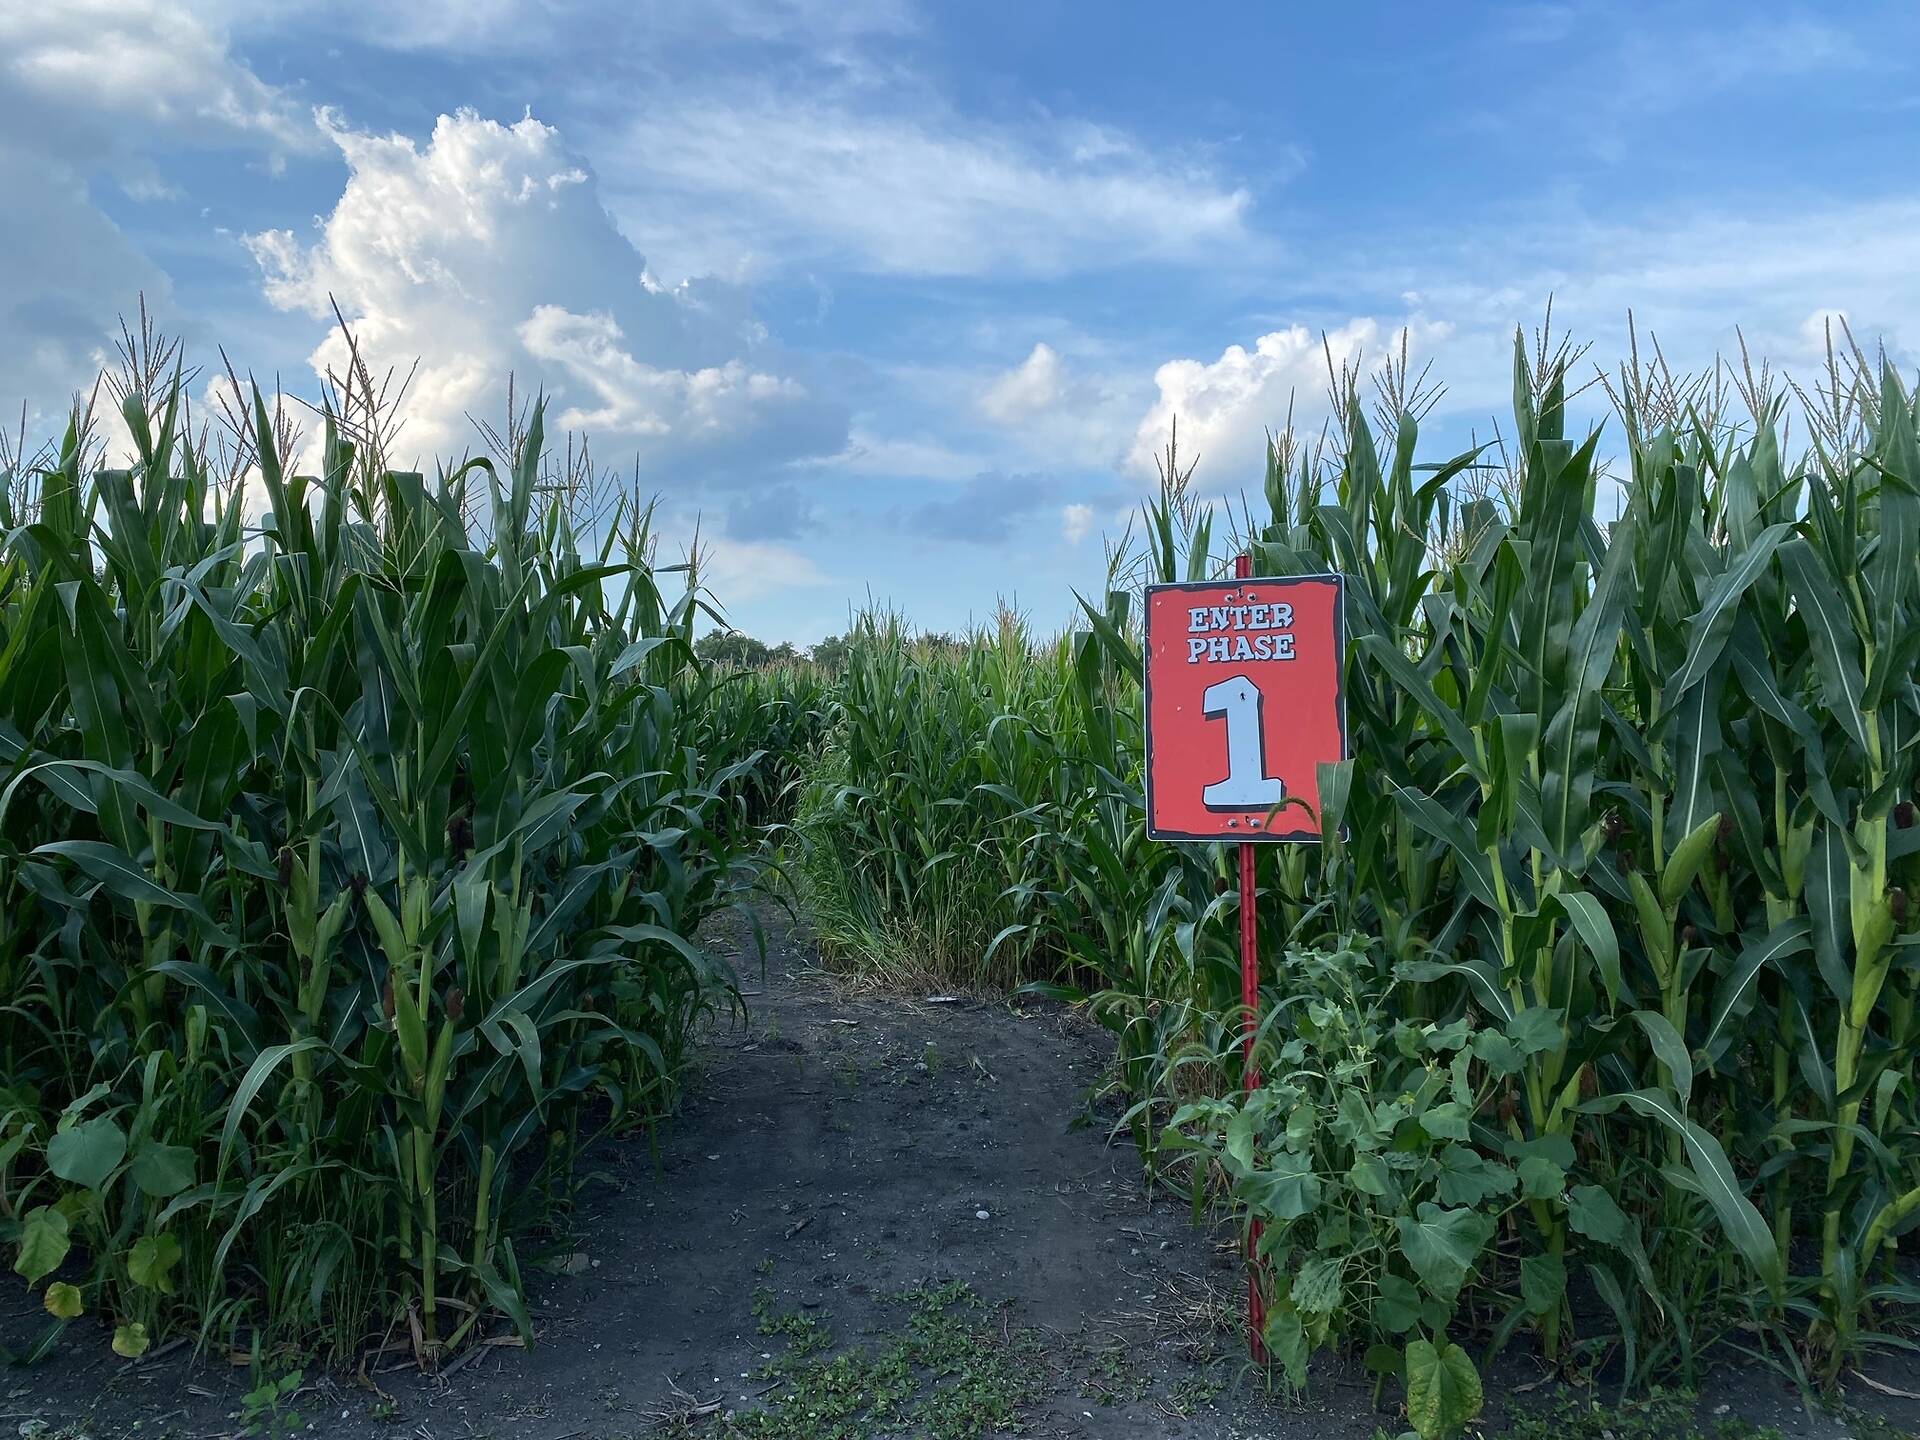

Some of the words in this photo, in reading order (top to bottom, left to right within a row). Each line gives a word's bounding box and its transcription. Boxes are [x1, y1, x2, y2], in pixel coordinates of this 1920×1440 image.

[1188, 603, 1293, 632] ENTER
[1187, 633, 1295, 663] PHASE
[1202, 675, 1285, 810] 1
